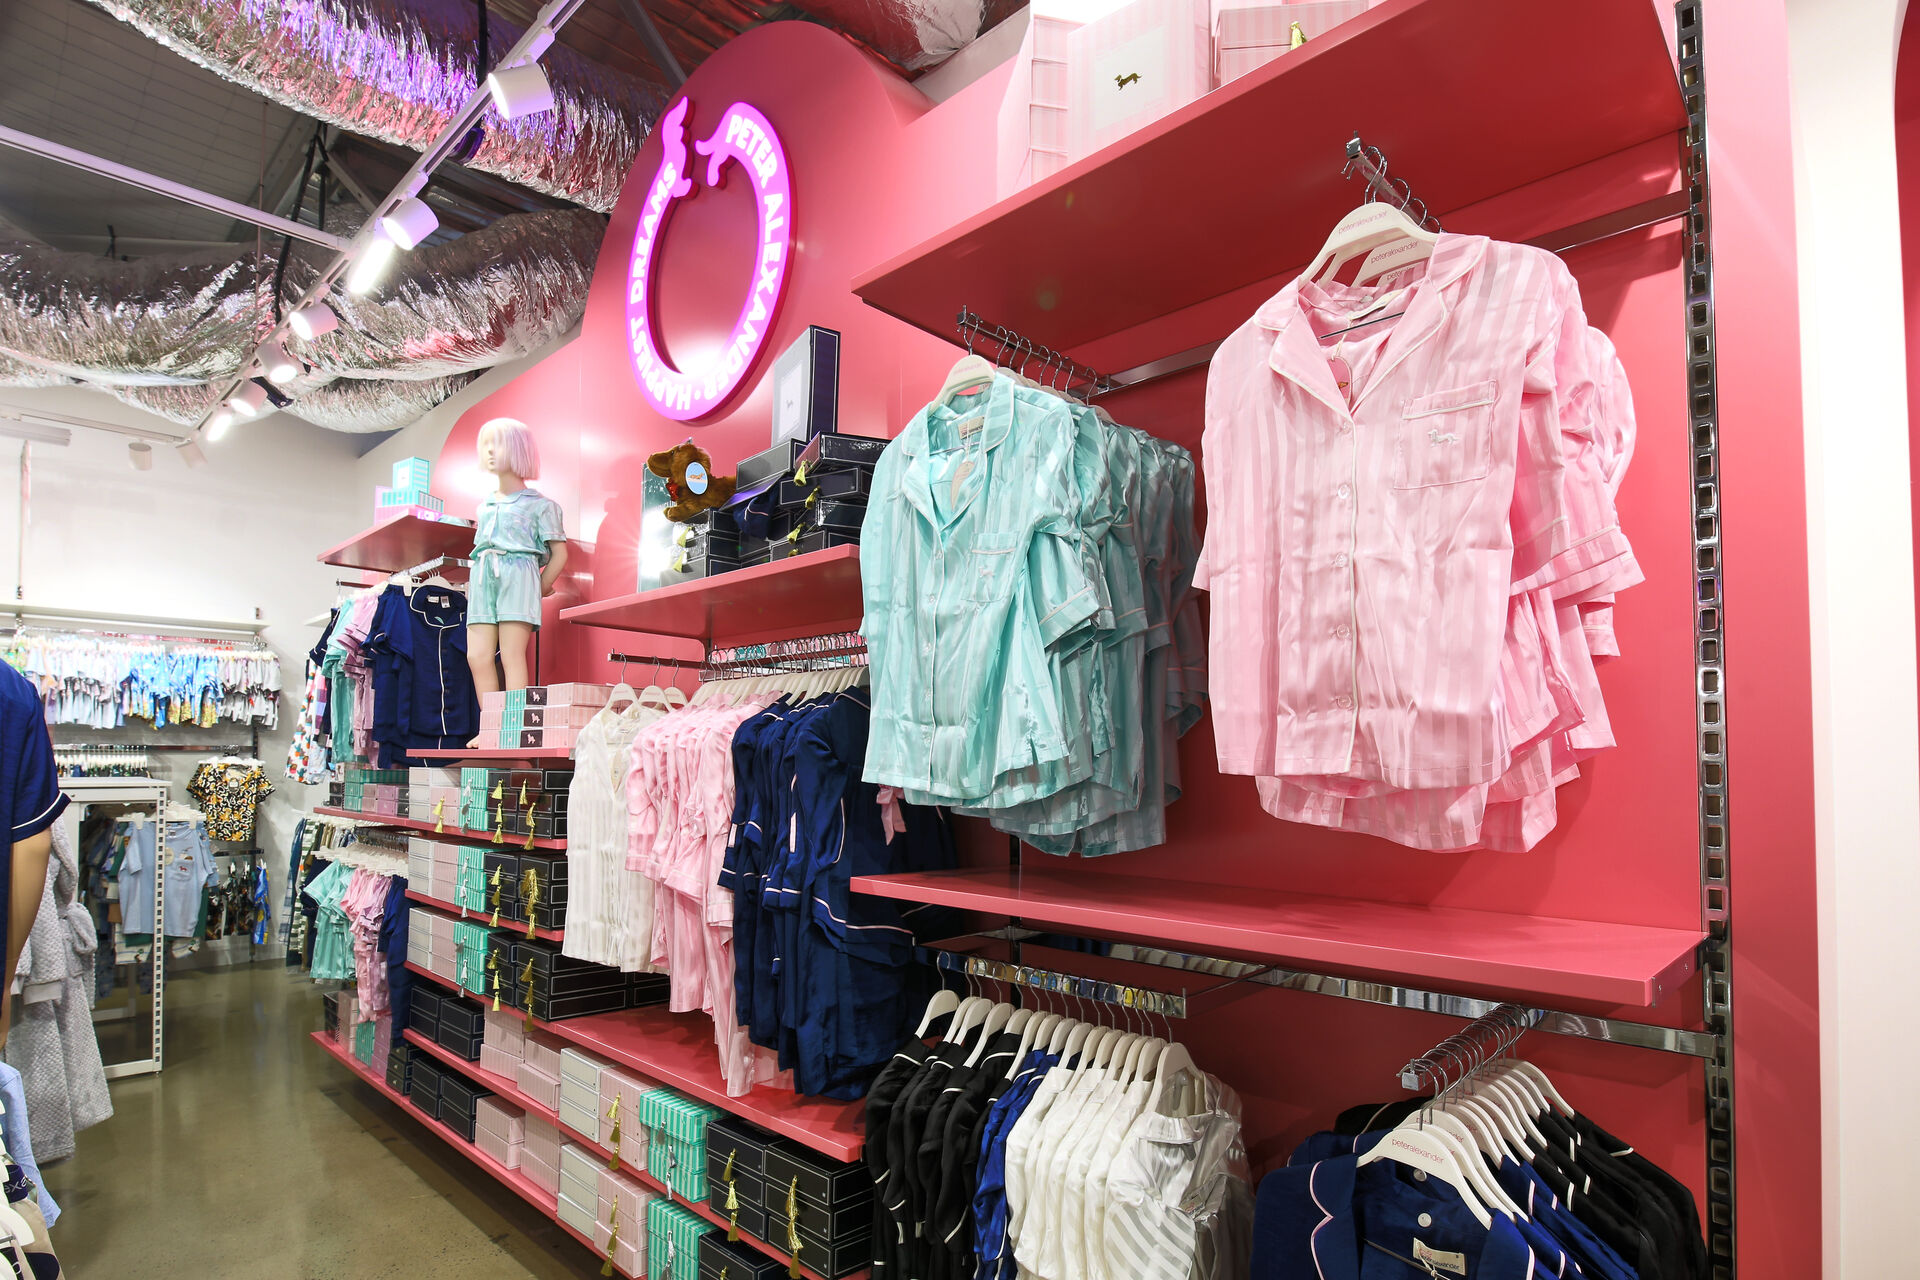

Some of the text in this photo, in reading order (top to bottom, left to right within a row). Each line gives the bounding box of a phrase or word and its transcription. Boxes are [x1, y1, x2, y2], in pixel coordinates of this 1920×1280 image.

[630, 114, 784, 411] PETER ALEXANDER HAPPIEST DREAMS
[1370, 240, 1418, 264] peteralexander
[1391, 1138, 1445, 1164] peteralexander
